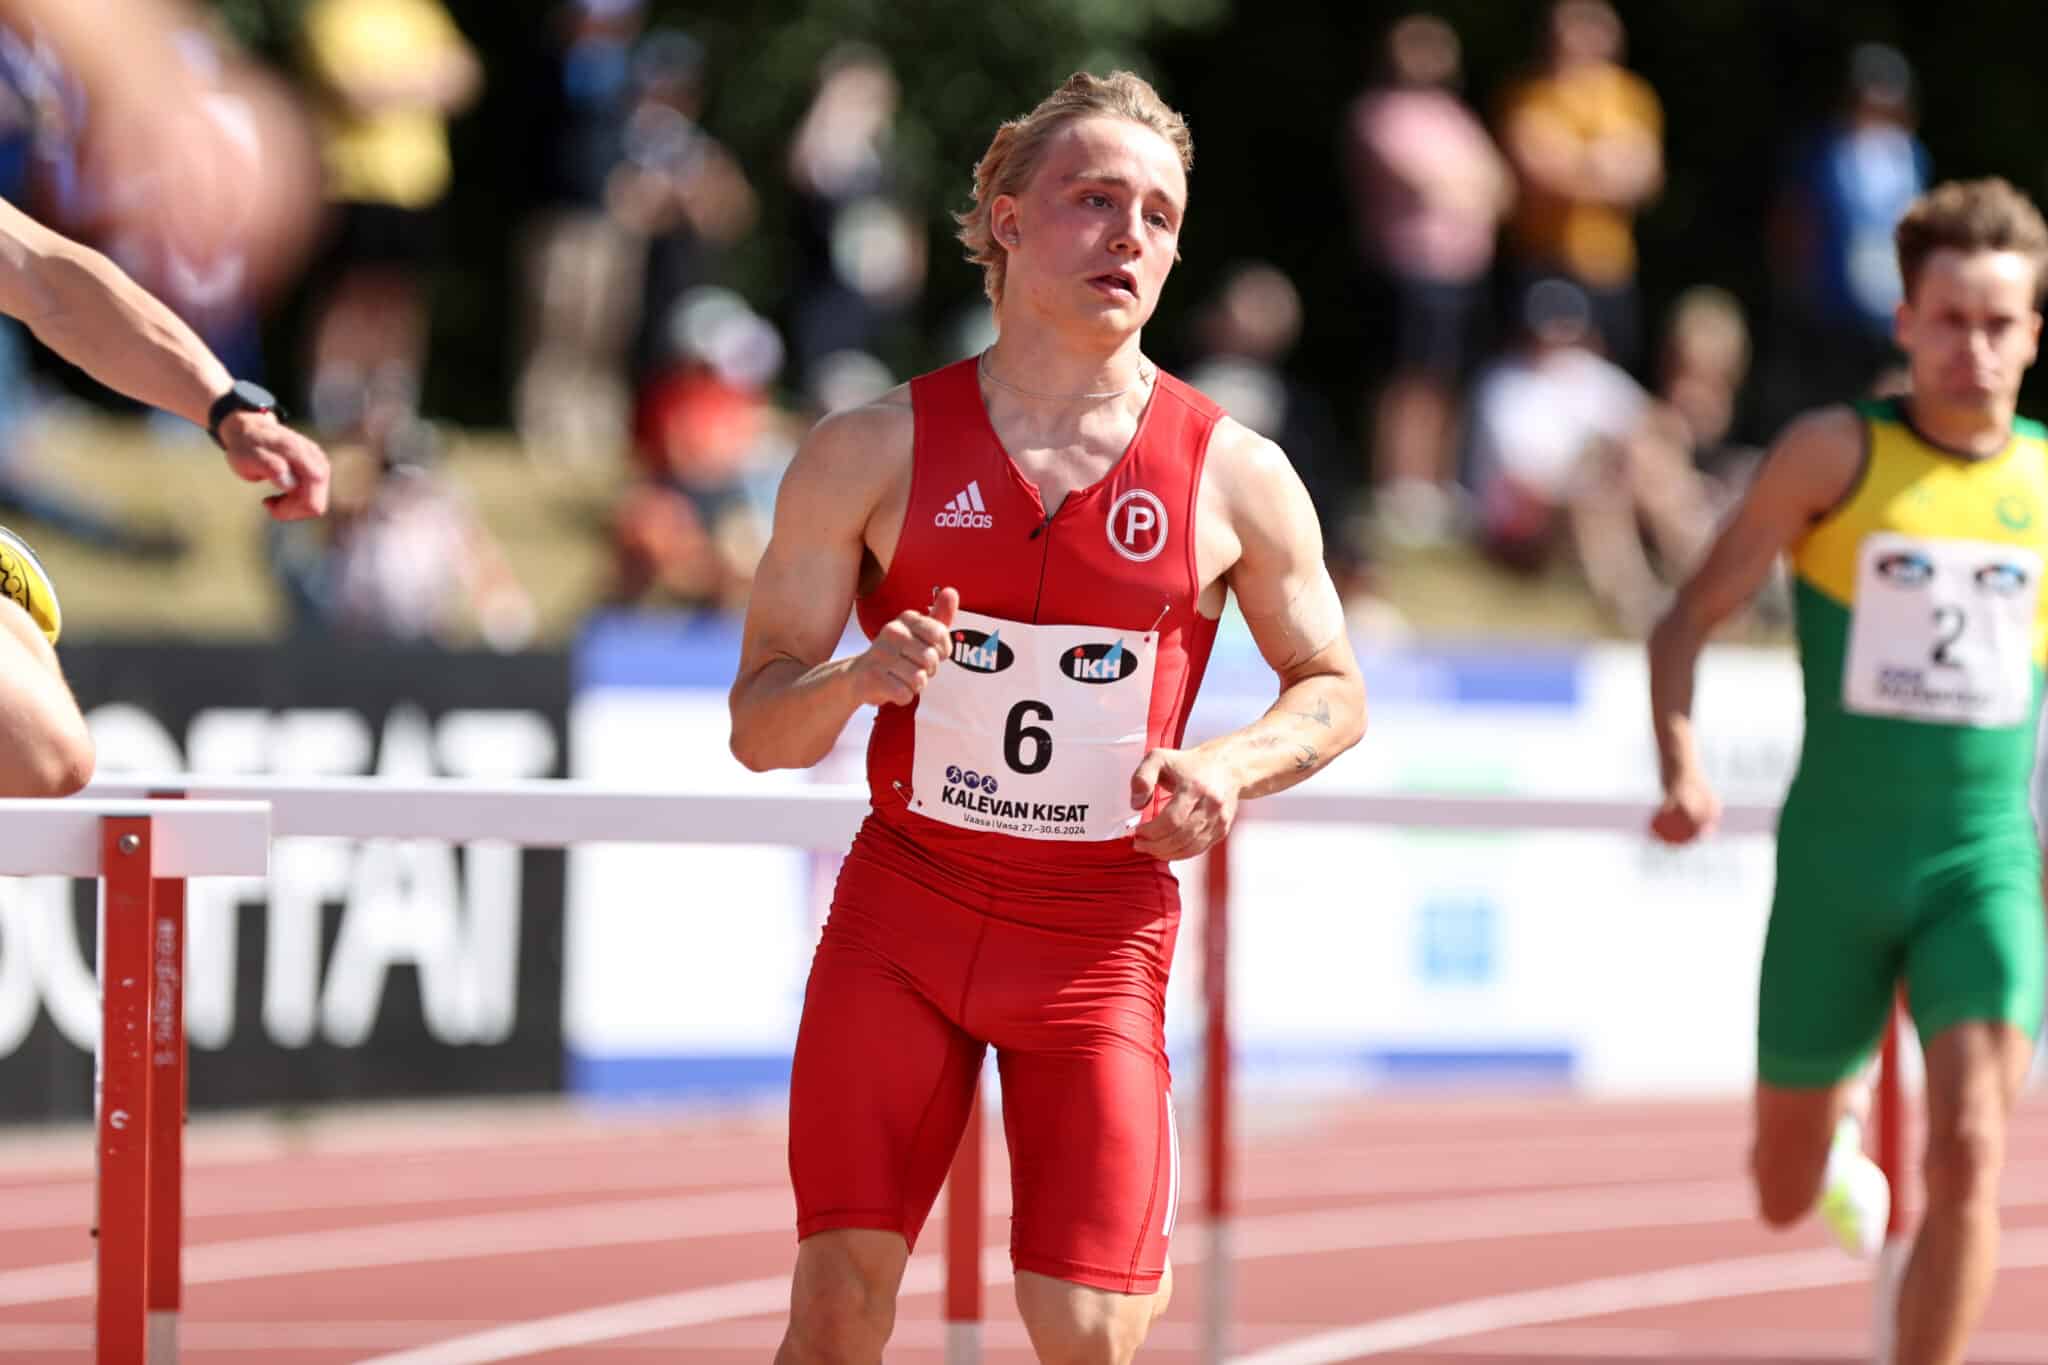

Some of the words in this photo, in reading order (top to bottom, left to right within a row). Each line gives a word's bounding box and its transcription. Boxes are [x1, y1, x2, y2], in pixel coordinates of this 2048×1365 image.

[934, 509, 993, 529] adidas
[1124, 505, 1156, 545] P
[1931, 603, 1966, 670] 2
[1003, 699, 1055, 775] 6
[941, 785, 1029, 820] KALEVAN
[1032, 803, 1089, 823] KISAT
